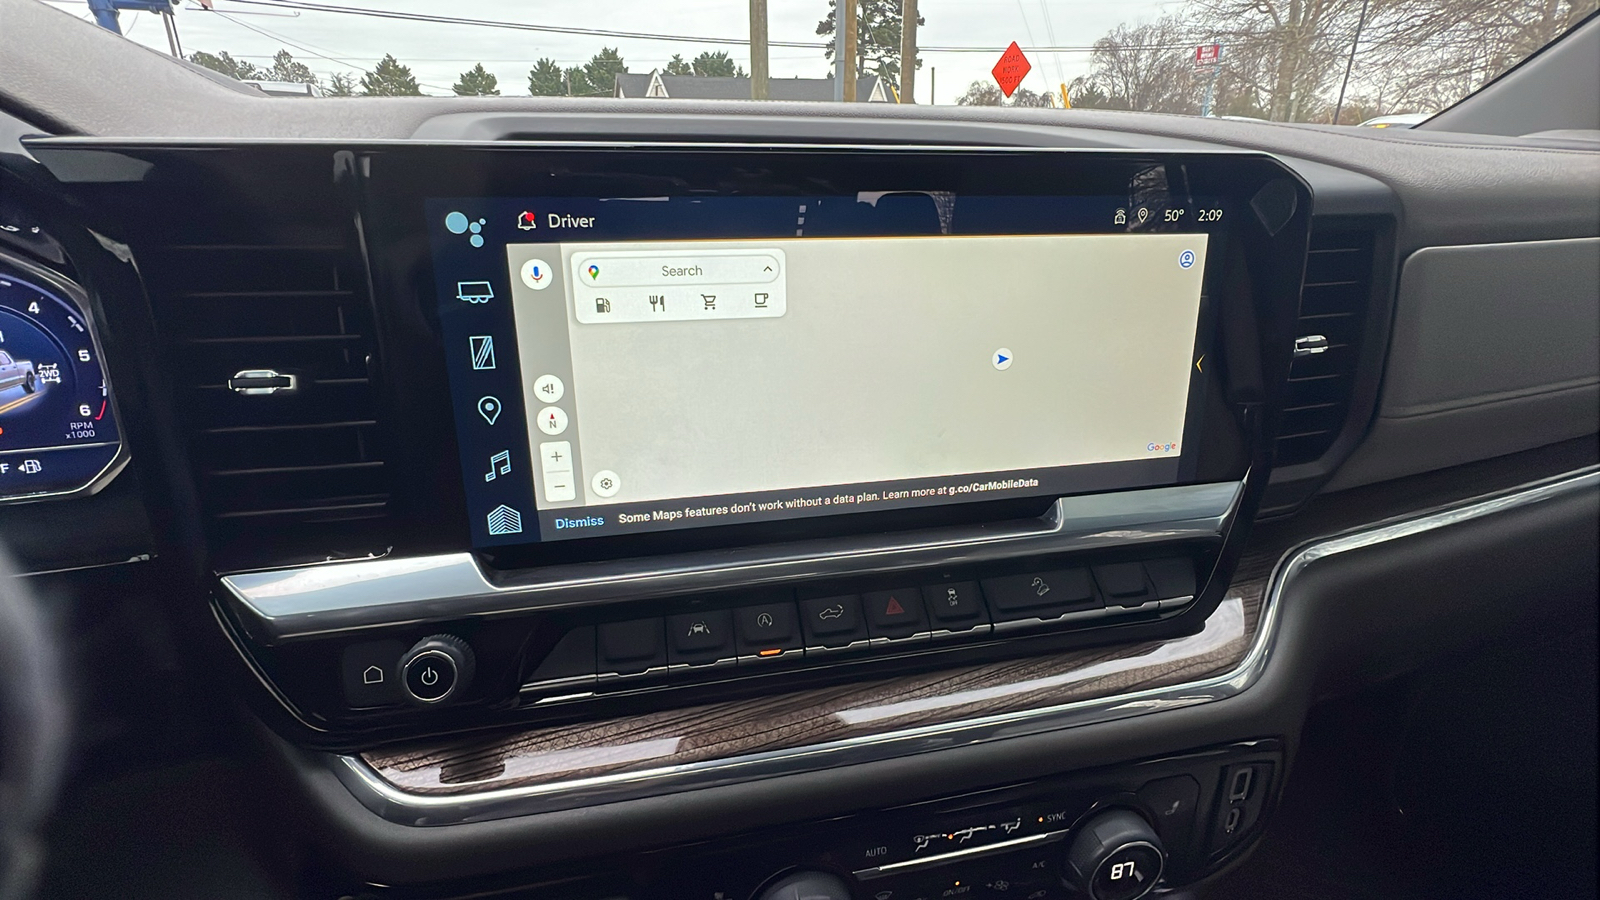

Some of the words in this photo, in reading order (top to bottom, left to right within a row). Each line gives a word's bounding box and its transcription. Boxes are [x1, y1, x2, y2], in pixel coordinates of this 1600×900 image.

[1004, 55, 1019, 63] ROAD
[547, 212, 595, 229] Driver
[1164, 208, 1185, 222] 50°
[1198, 209, 1223, 222] 2:09
[661, 264, 703, 278] Search
[28, 301, 40, 315] 4
[77, 349, 91, 362] 5
[38, 368, 60, 379] 2WD
[79, 404, 91, 417] 6
[70, 422, 93, 430] RPM
[549, 420, 557, 429] N
[65, 430, 95, 439] x1000
[1147, 442, 1176, 453] Google
[0, 462, 10, 474] F
[555, 515, 605, 530] Dismiss
[618, 513, 651, 525] Some
[652, 509, 683, 522] Maps
[684, 504, 729, 517] features
[730, 501, 757, 514] don't
[758, 499, 784, 512] work
[786, 494, 822, 509] without
[824, 497, 832, 506] a
[833, 493, 855, 505] data
[857, 491, 880, 504] plan.
[883, 488, 909, 501] Learn
[911, 487, 935, 499] more
[937, 485, 947, 496] at
[948, 477, 1039, 496] g.co/CarMobileData
[1047, 811, 1066, 823] SYNC
[865, 846, 887, 857] AUTO
[1110, 861, 1135, 880] 87
